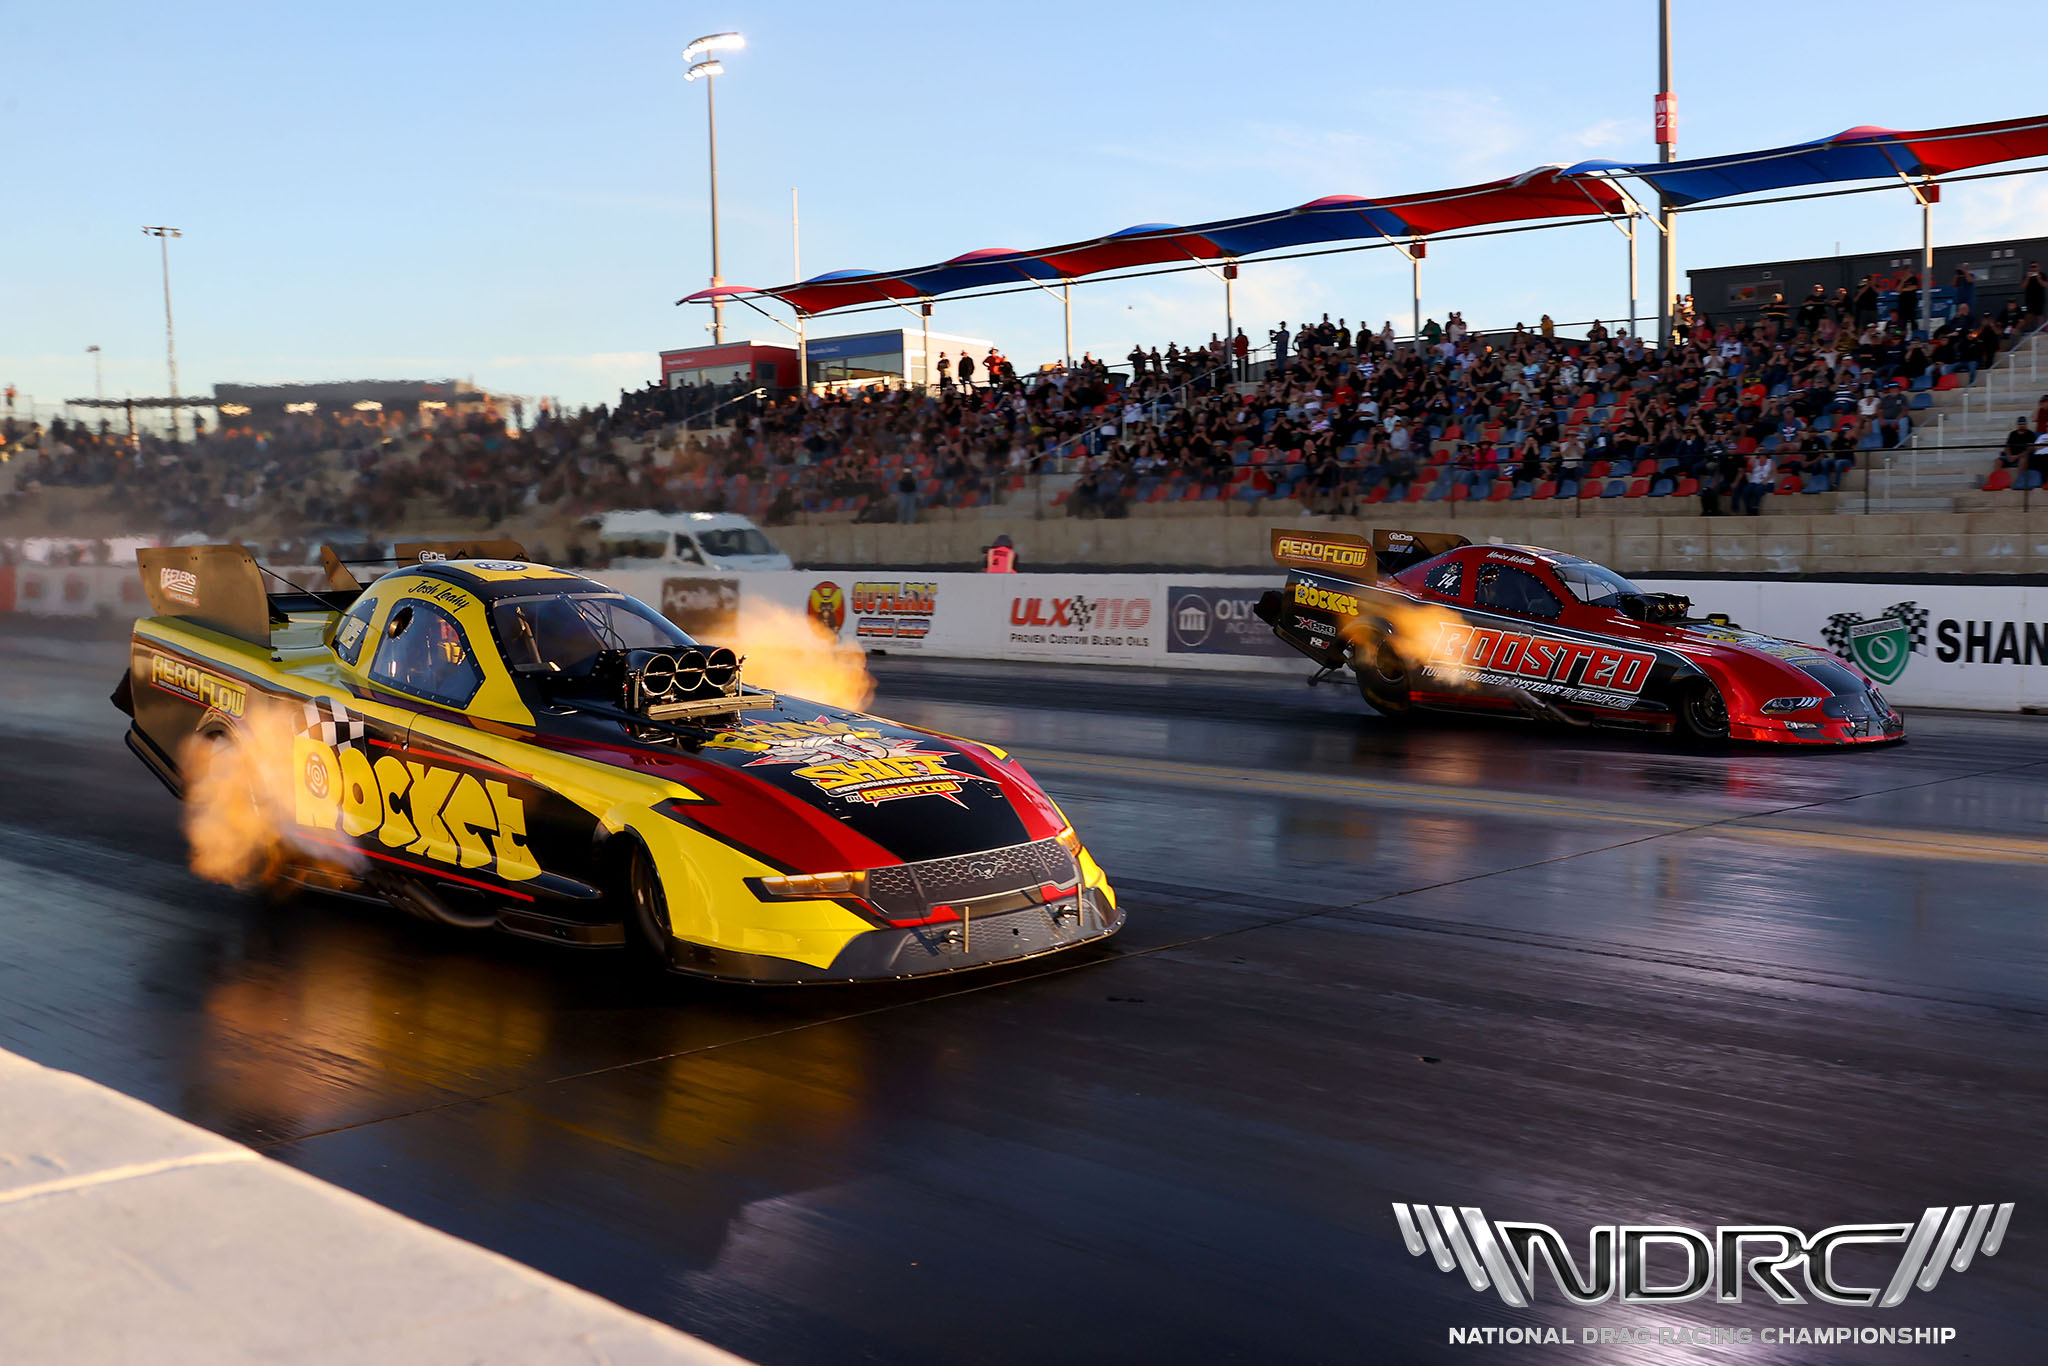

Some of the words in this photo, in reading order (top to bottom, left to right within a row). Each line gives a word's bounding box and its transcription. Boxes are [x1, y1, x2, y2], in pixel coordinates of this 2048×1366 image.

[1278, 539, 1368, 566] AEROFLOW
[408, 580, 440, 596] Josh
[1437, 573, 1457, 589] 74
[852, 582, 937, 616] OUTLAW
[1215, 599, 1260, 620] OLY
[1010, 597, 1072, 627] ULX
[1094, 598, 1151, 630] 110
[1428, 622, 1657, 695] BOOSTED
[151, 655, 246, 717] AEROFLOW
[793, 755, 952, 789] SHIFT
[836, 777, 907, 794] PERFORMANCE
[860, 781, 958, 801] AEROFLOW
